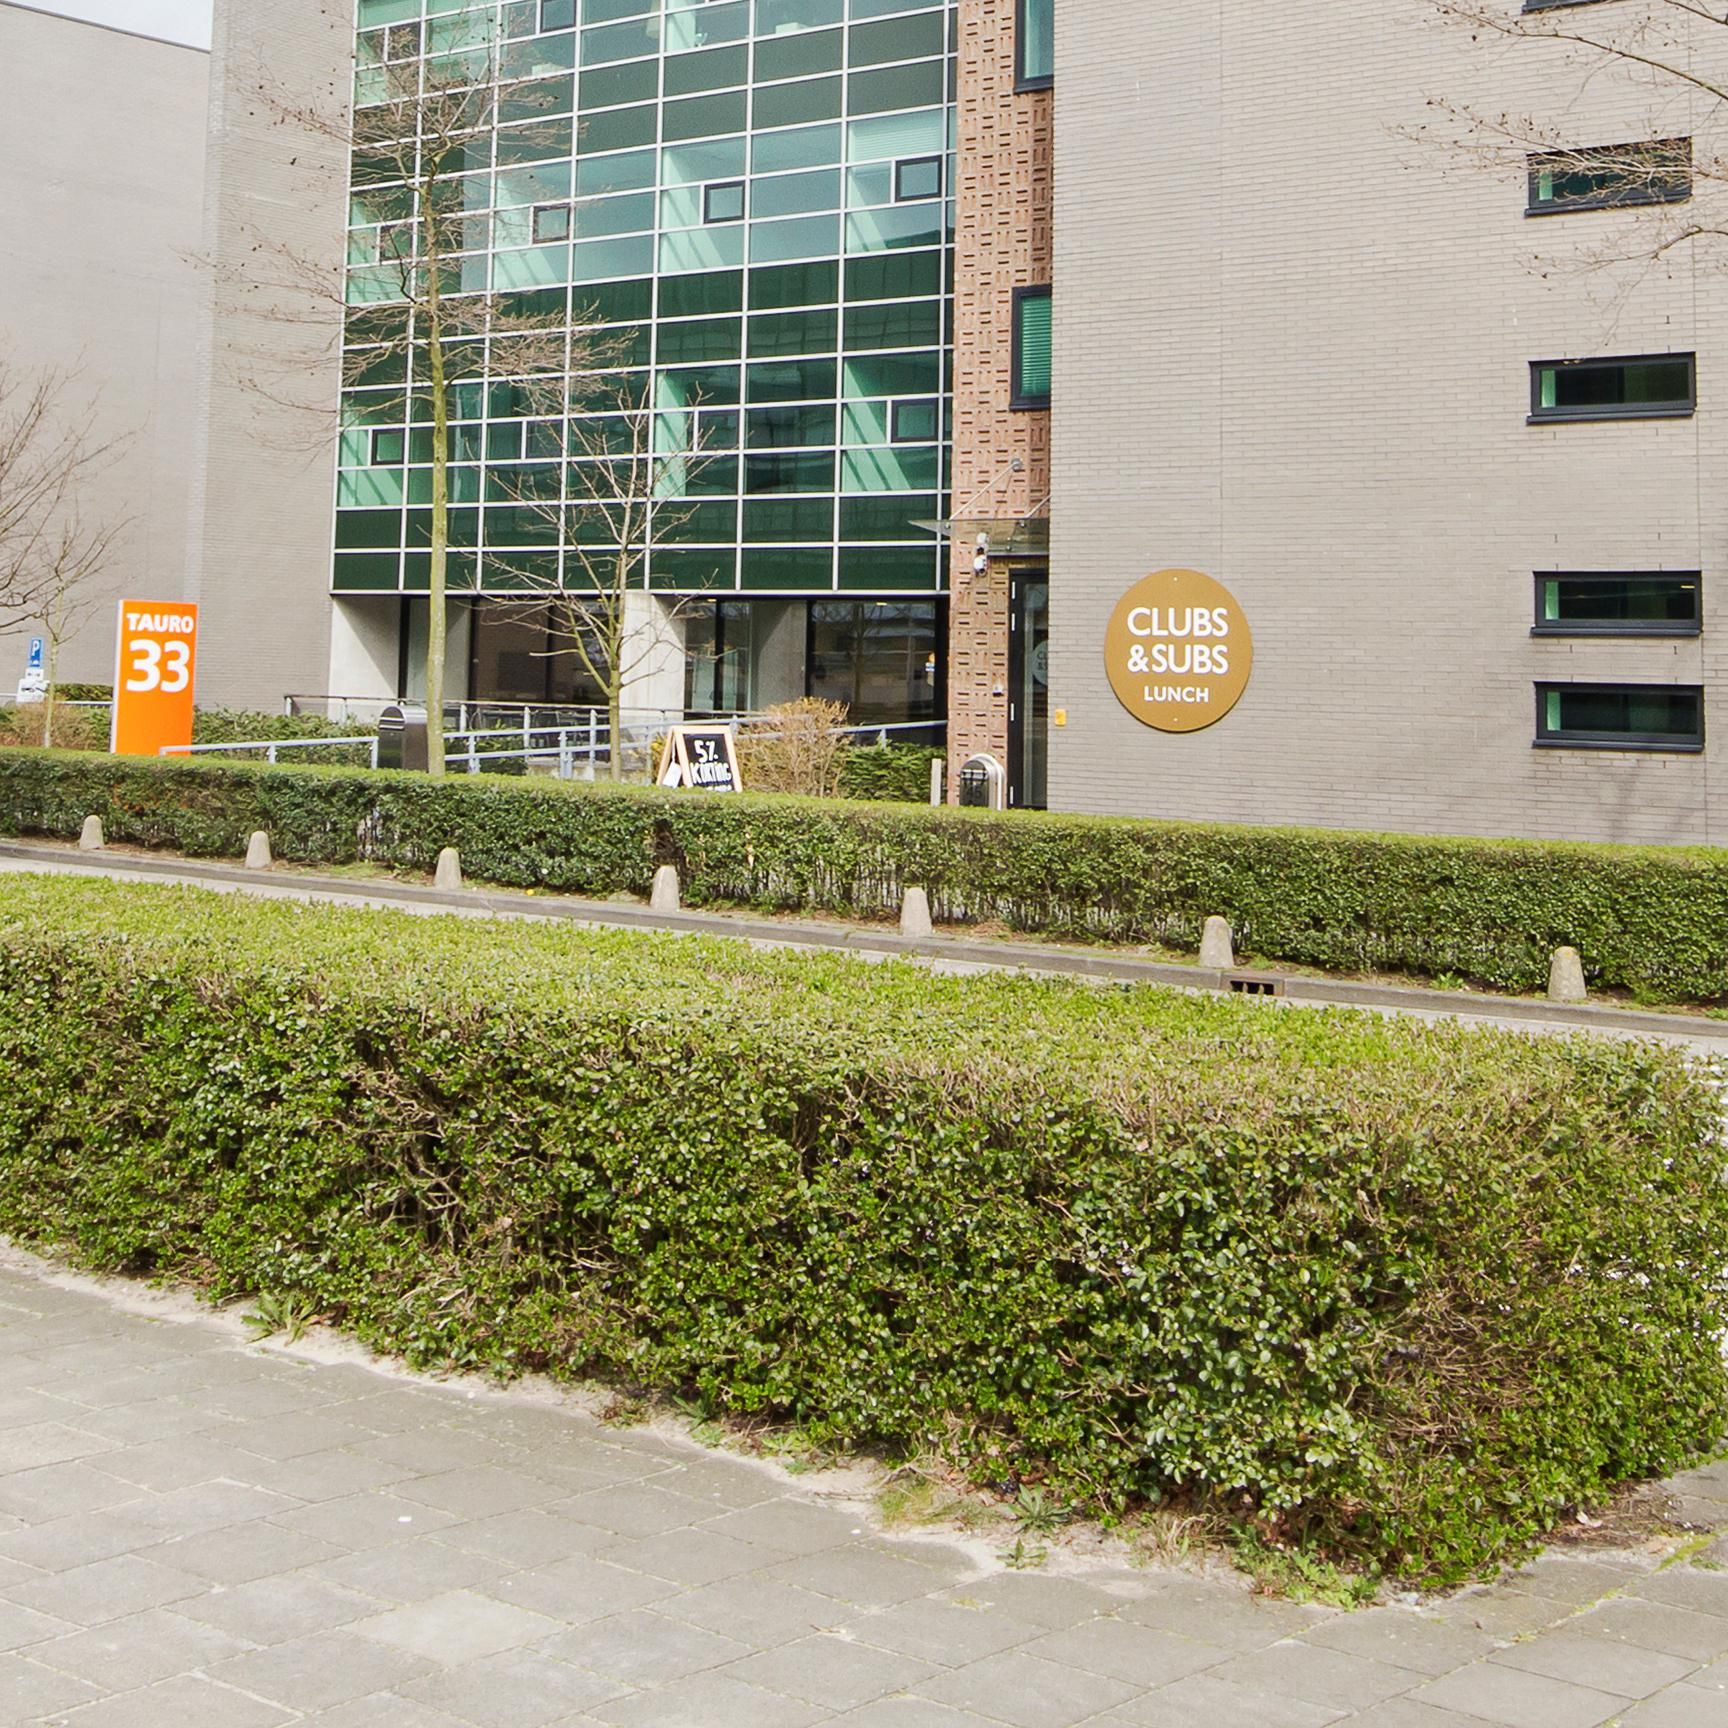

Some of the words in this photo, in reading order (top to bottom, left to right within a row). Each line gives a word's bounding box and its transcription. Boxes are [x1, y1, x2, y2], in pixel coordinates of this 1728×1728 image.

[125, 613, 194, 634] TAURO
[1127, 606, 1229, 637] CLUBS
[125, 639, 191, 693] 33
[1144, 685, 1210, 703] LUNCH
